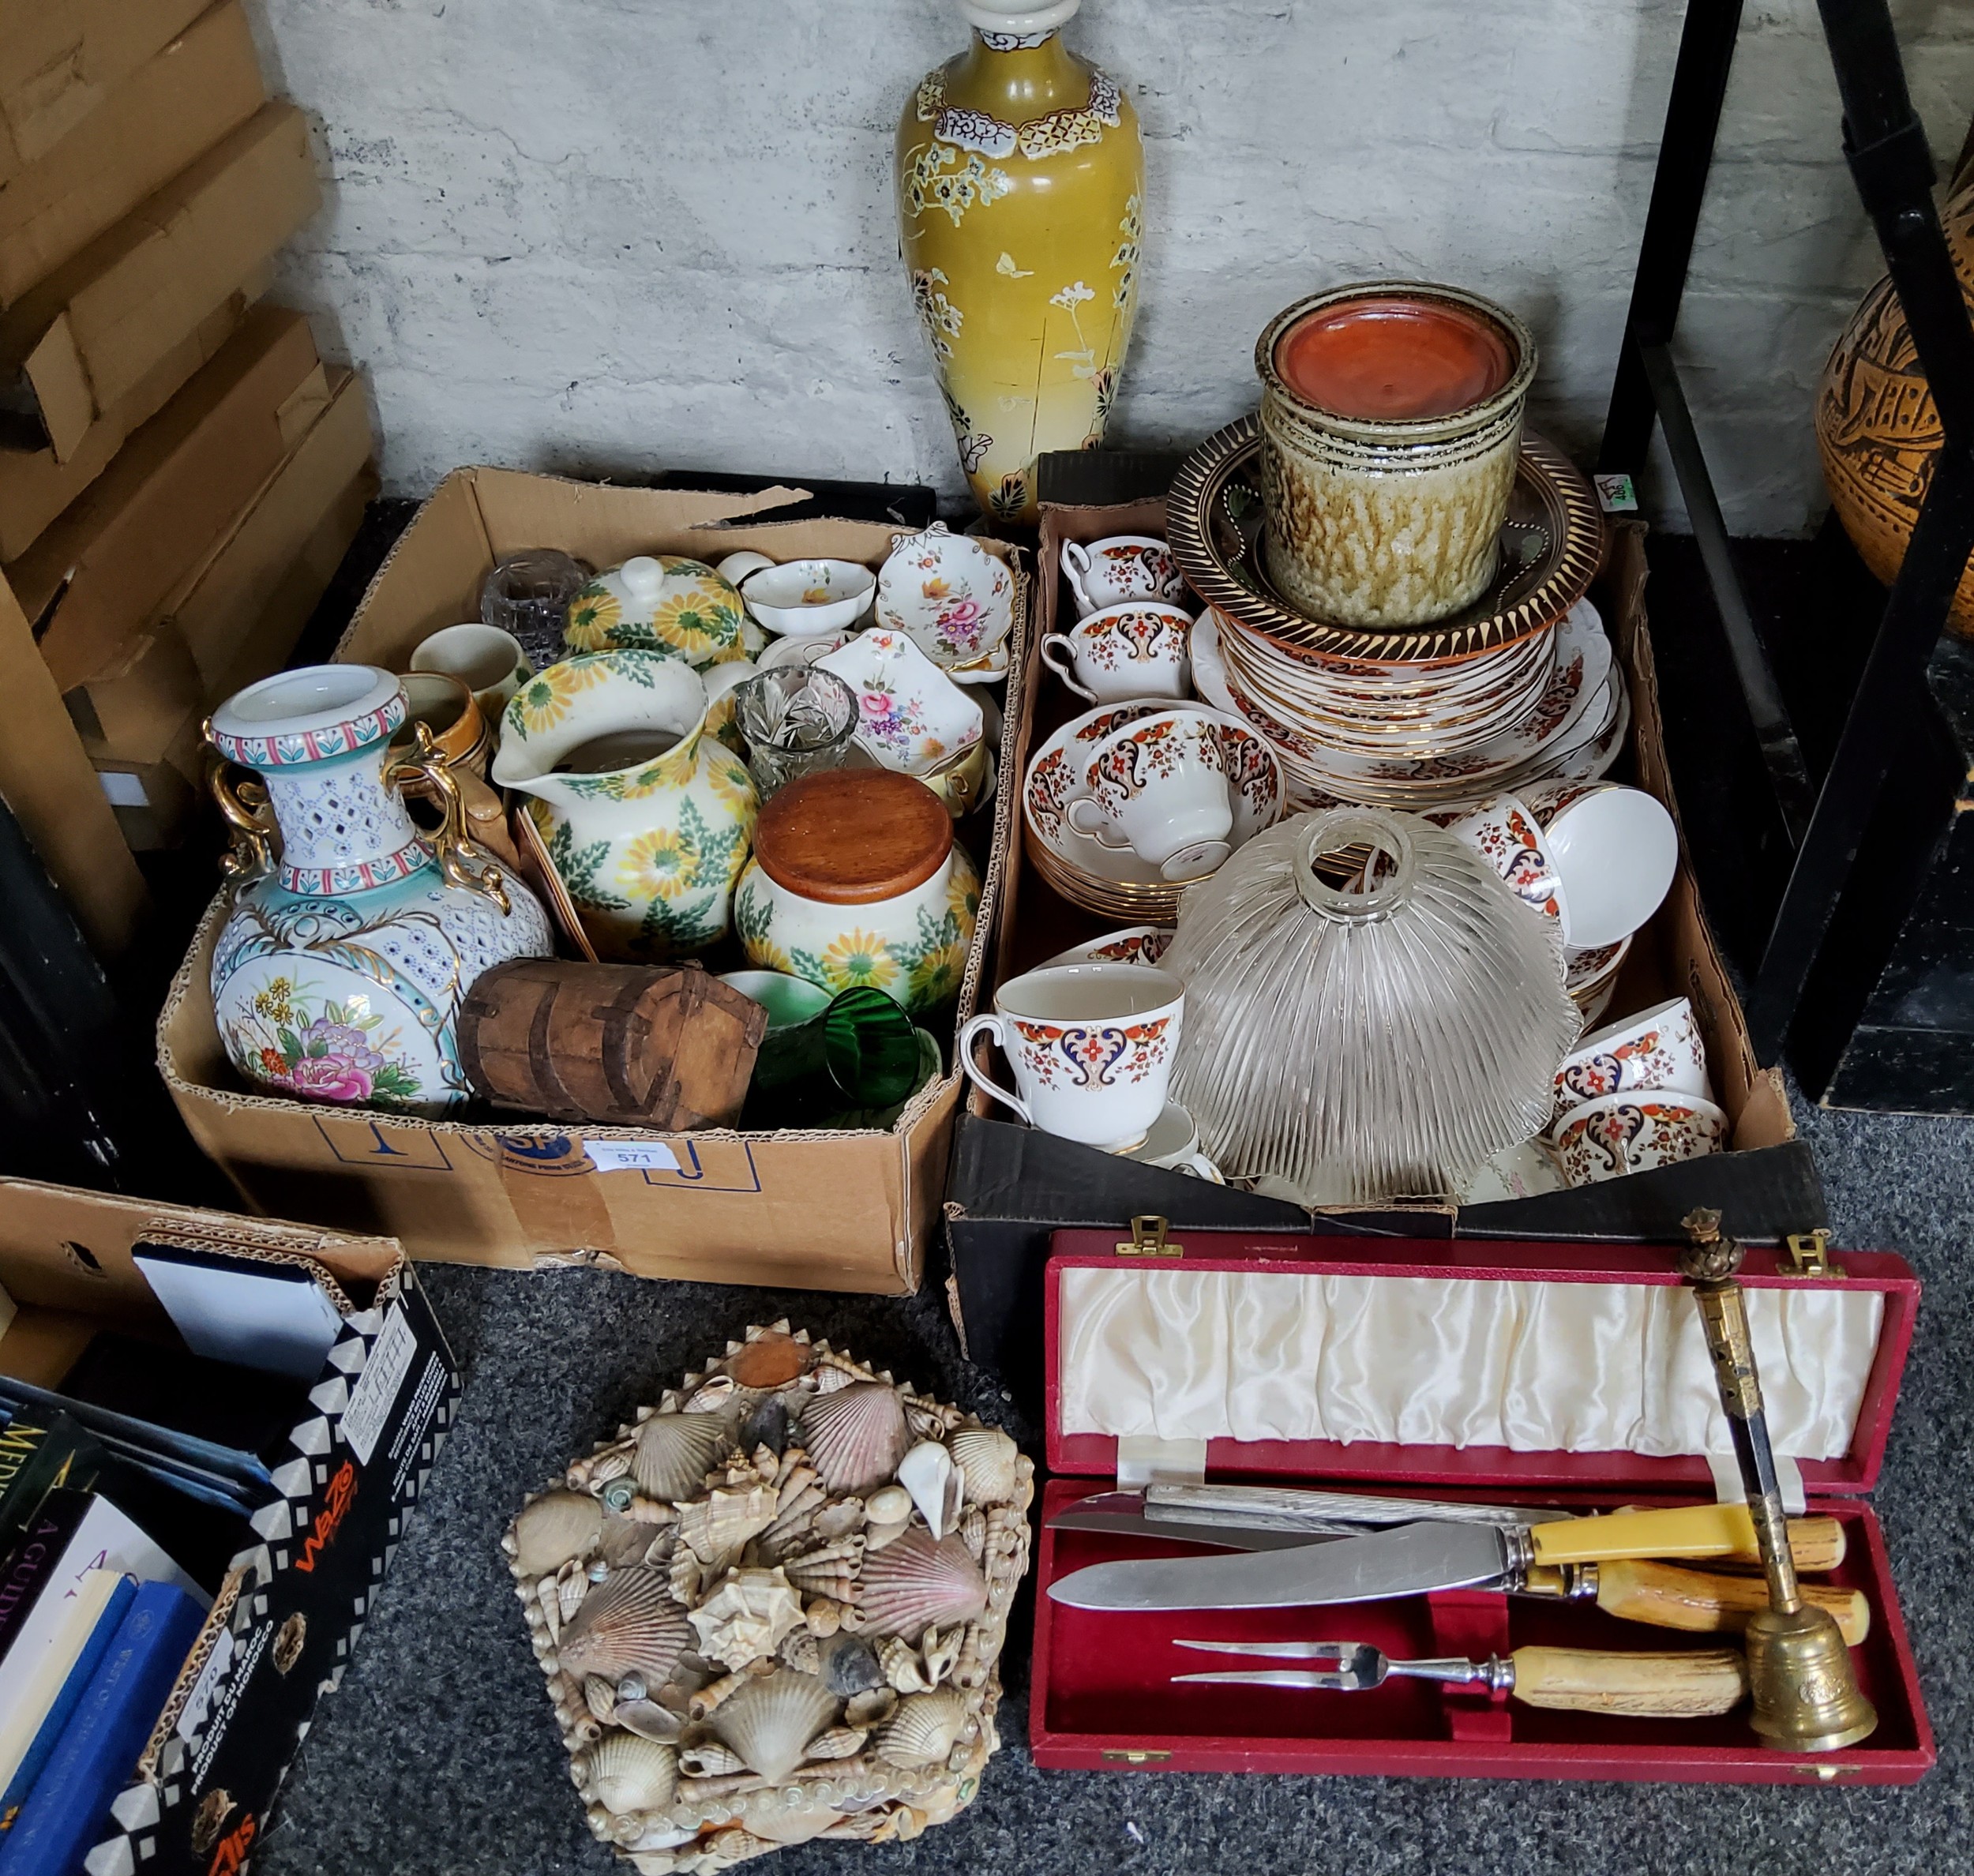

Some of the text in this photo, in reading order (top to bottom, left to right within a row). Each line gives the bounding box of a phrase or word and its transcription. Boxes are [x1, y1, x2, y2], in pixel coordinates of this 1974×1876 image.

[617, 1153, 652, 1164] 571
[0, 1542, 47, 1626] GUID
[190, 1724, 227, 1795] PRODUCT
[226, 1698, 238, 1720] OF
[236, 1620, 273, 1698] MOROCCO
[191, 1706, 225, 1773] PRODUIT
[224, 1682, 236, 1706] DU
[235, 1626, 262, 1683] MAROC
